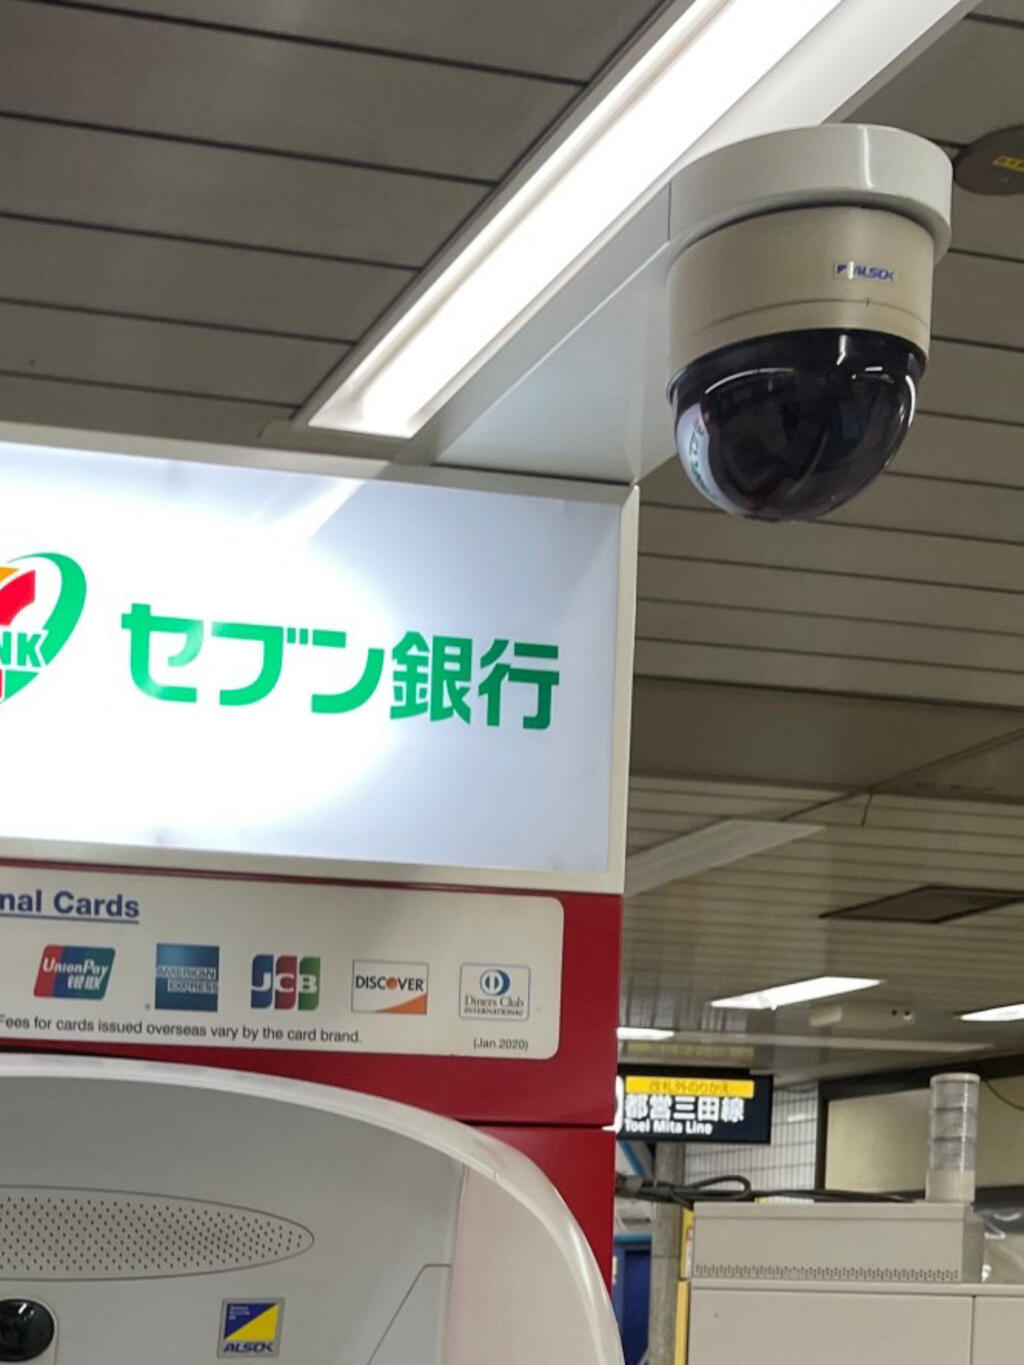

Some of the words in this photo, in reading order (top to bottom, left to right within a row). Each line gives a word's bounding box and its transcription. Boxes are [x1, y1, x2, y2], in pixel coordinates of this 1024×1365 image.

[121, 602, 561, 731] セブン銀行
[53, 890, 140, 918] Cards
[43, 957, 109, 980] UnionPay
[355, 975, 424, 991] DISCOVER
[34, 1016, 52, 1030] for
[56, 1018, 94, 1032] cards
[98, 1020, 142, 1034] issued
[146, 1024, 206, 1036] overseas
[210, 1027, 238, 1040] vary
[242, 1025, 258, 1040] by
[262, 1026, 283, 1040] the
[287, 1028, 316, 1041] card
[320, 1029, 362, 1043] brand.
[473, 1037, 496, 1049] (Jan
[653, 1121, 683, 1134] Mita
[686, 1121, 713, 1135] Line
[223, 1342, 274, 1353] ALSOK
